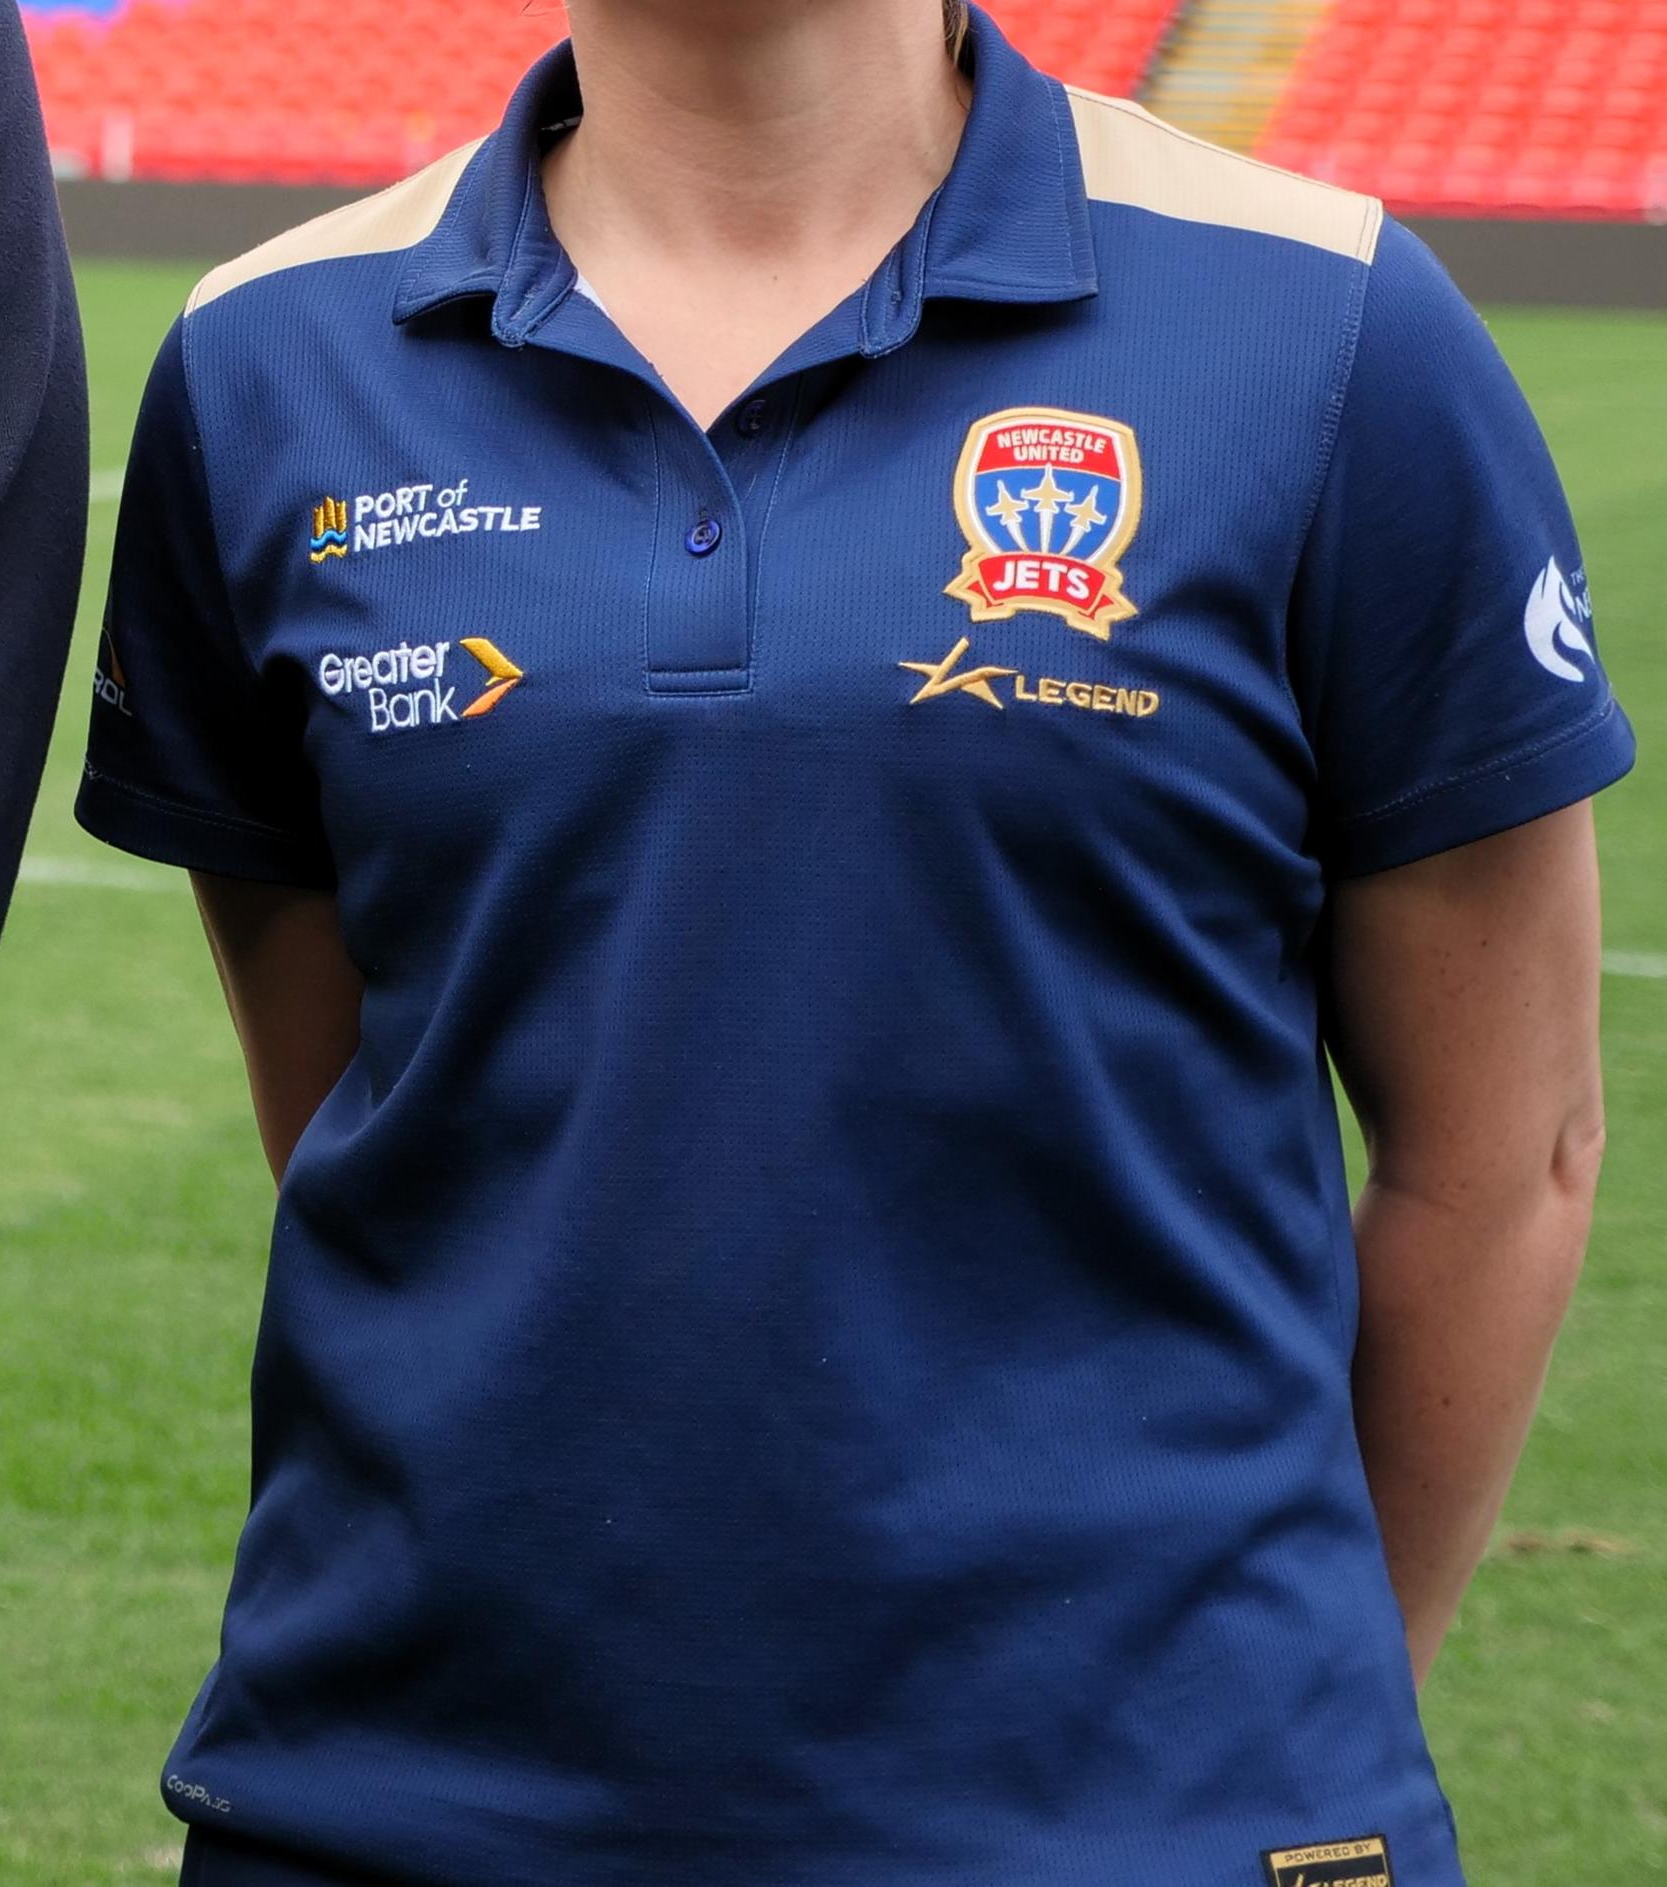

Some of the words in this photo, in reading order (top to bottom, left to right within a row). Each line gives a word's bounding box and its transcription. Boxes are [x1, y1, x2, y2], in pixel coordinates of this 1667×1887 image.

[997, 428, 1107, 454] NEWCASTLE
[1013, 444, 1084, 464] UNITED
[355, 484, 433, 522] PORT
[437, 479, 468, 508] of
[354, 506, 542, 552] NEWCASTLE
[992, 560, 1090, 600] JETS
[319, 641, 450, 695] Greater
[369, 677, 458, 733] Bank
[1015, 675, 1160, 718] LEGEND
[1283, 1846, 1350, 1863] POWERED
[1354, 1842, 1372, 1857] BY
